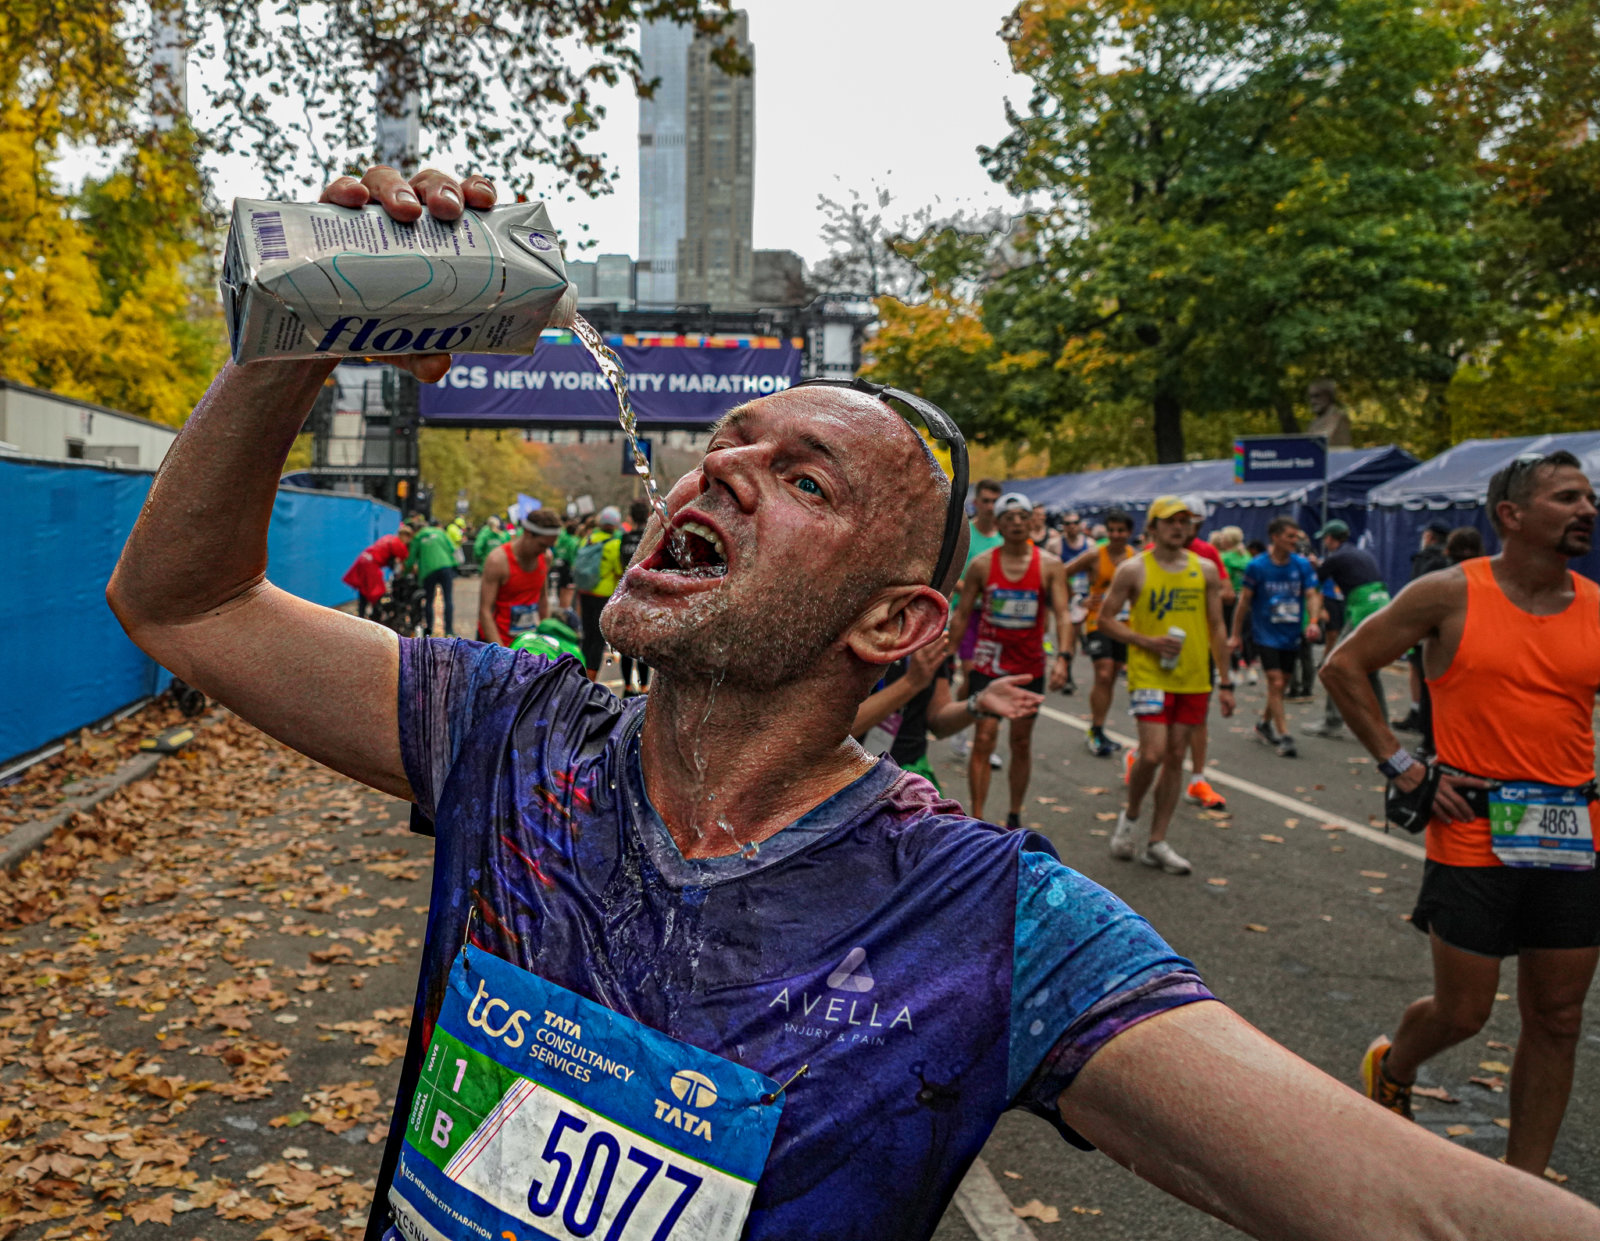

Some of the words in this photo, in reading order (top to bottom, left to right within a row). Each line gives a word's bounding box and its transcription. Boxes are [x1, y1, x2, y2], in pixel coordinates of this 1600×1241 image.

[377, 217, 389, 250] Sustainability
[467, 232, 475, 248] Flow?
[315, 314, 473, 351] flow
[493, 371, 547, 389] NEW
[550, 371, 611, 390] YORK
[669, 373, 791, 393] MARATHON
[1539, 808, 1578, 836] 4863
[467, 979, 531, 1048] tcs
[544, 1010, 582, 1040] TATA
[769, 987, 913, 1030] AVELLA
[785, 1023, 832, 1039] INJURY
[837, 1033, 845, 1042] &
[852, 1034, 886, 1046] PAIN
[428, 1043, 440, 1072] WAVE
[529, 1044, 591, 1083] SERVICES
[536, 1028, 635, 1082] CONSULTANCY
[452, 1058, 468, 1094] 1
[410, 1092, 422, 1125] GREEN
[414, 1093, 429, 1132] CORRAL
[654, 1098, 712, 1142] TATA
[431, 1109, 454, 1149] B
[527, 1110, 703, 1241] 5077
[414, 1178, 427, 1194] NEW
[425, 1188, 439, 1204] YORK
[438, 1200, 452, 1215] CITY
[452, 1210, 493, 1240] MARATHON
